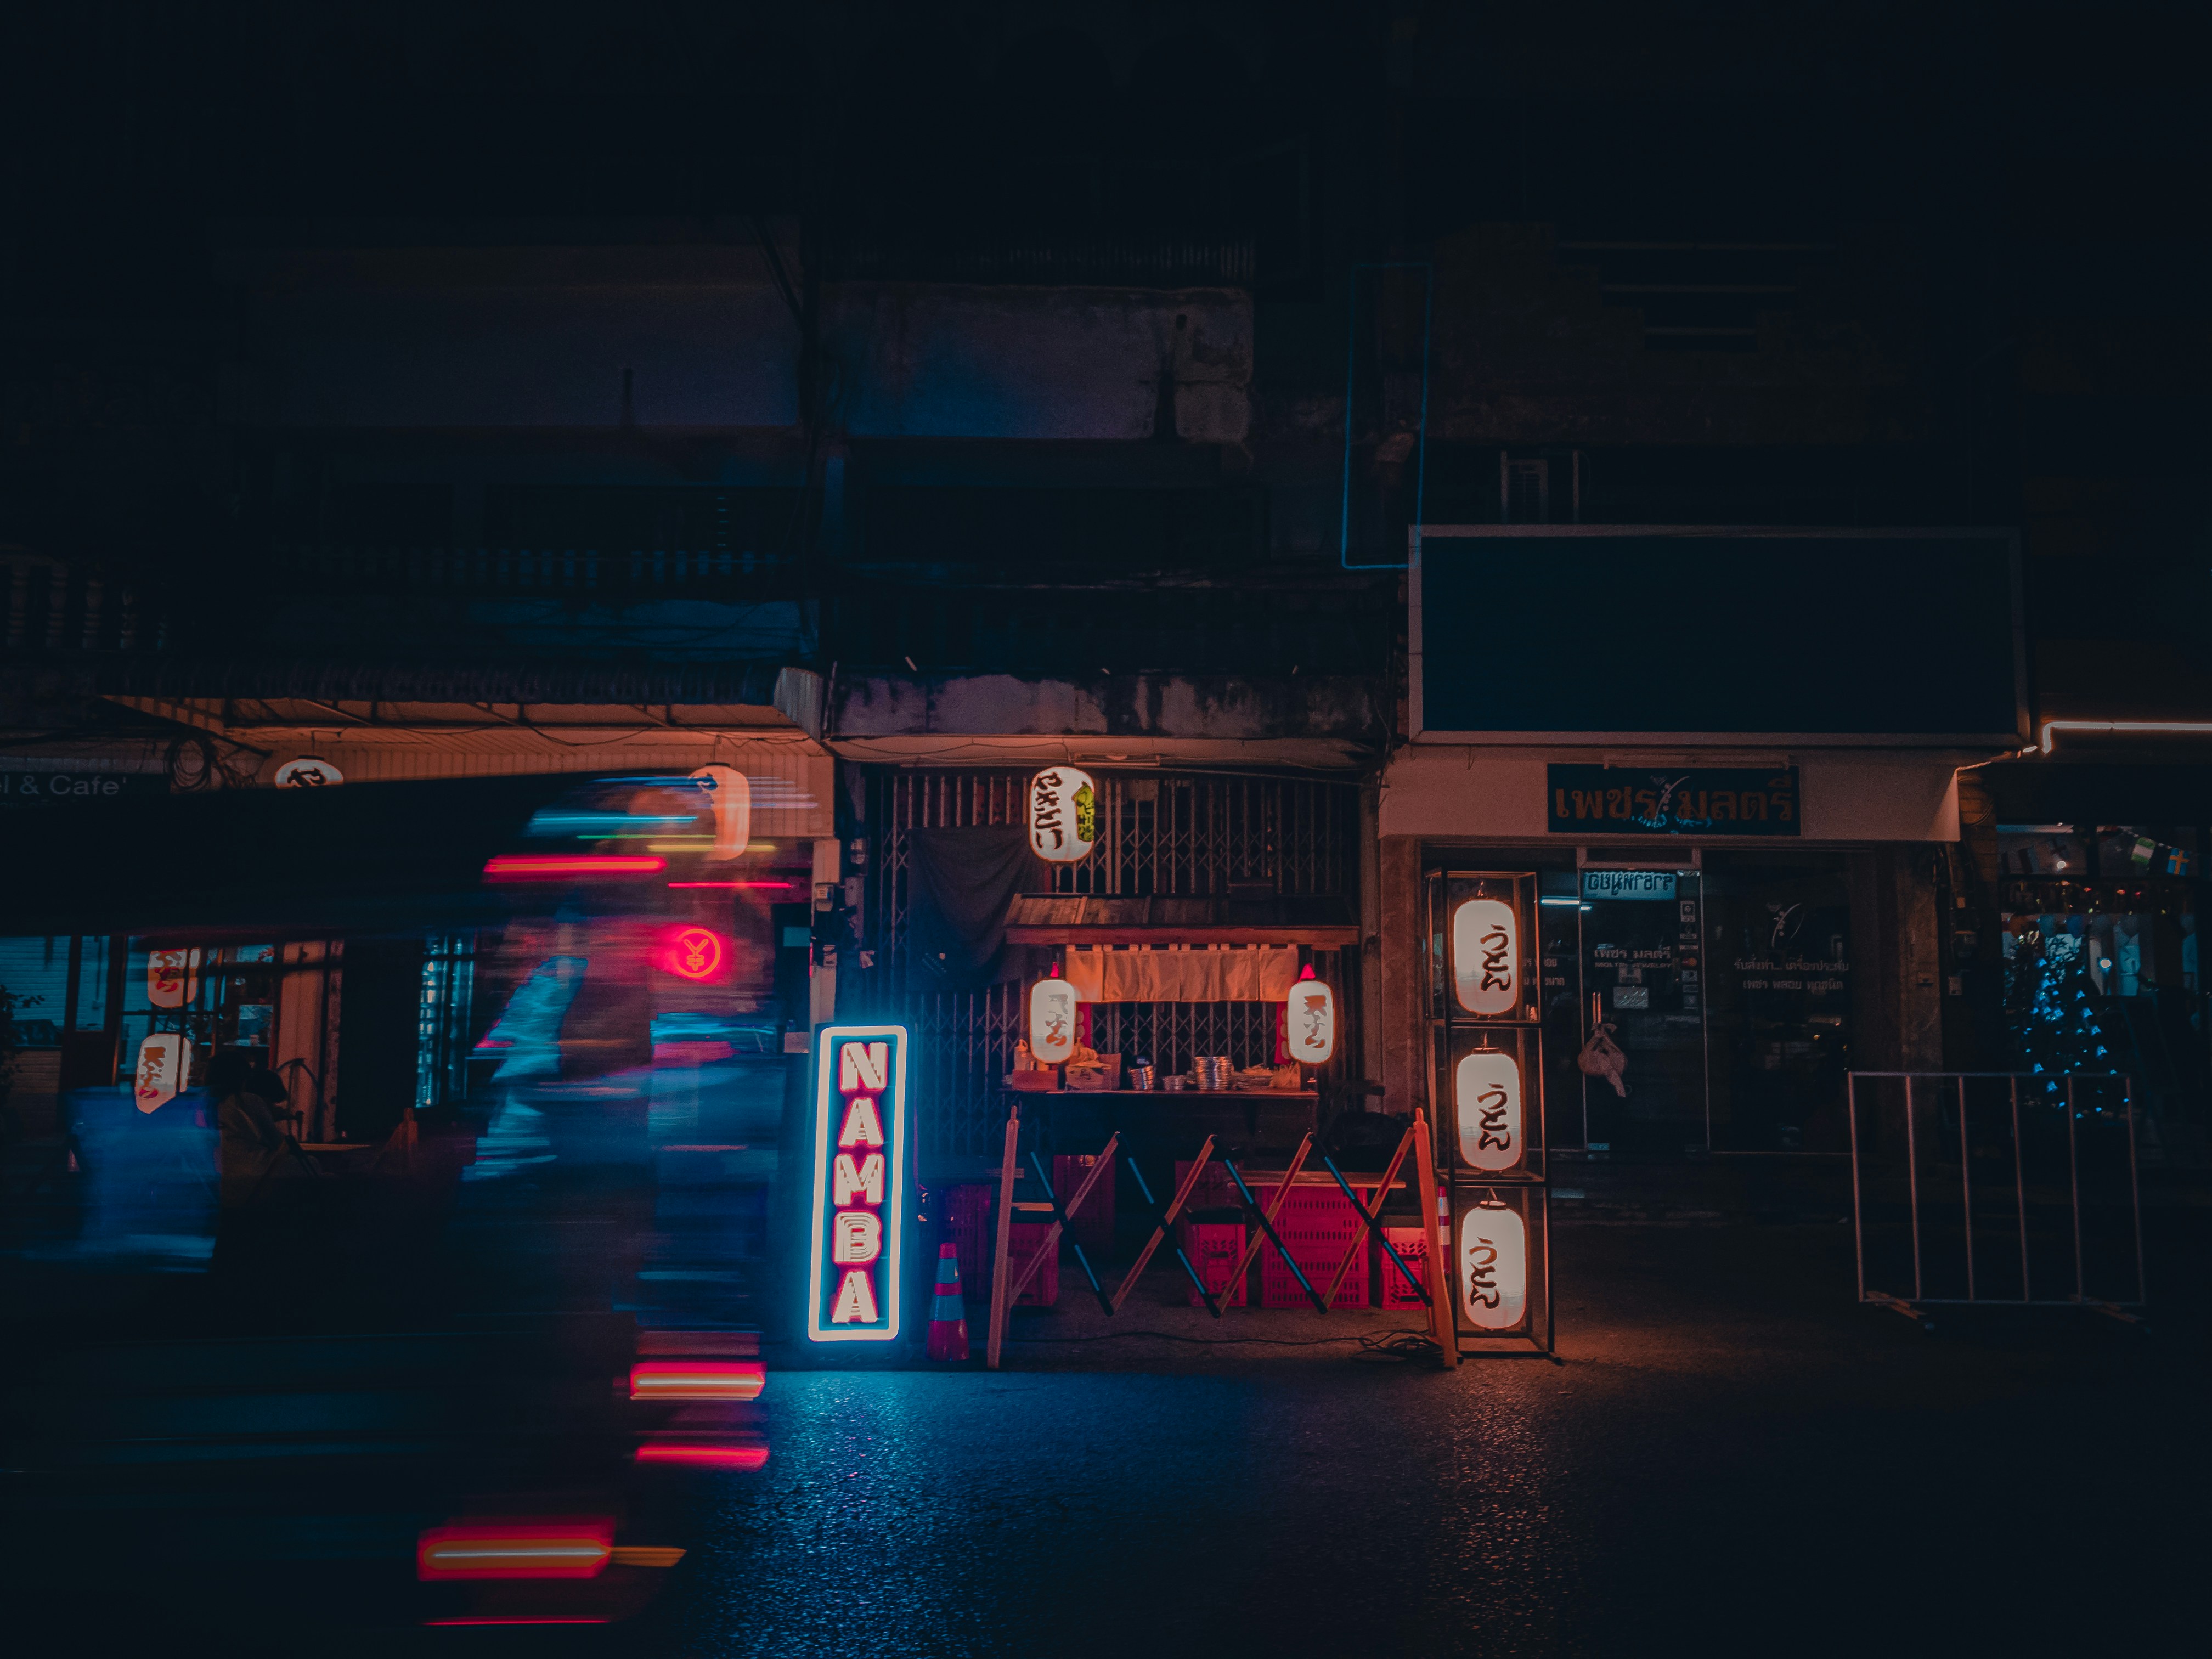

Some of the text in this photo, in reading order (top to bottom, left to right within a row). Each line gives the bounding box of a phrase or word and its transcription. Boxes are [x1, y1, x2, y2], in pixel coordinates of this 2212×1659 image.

[20, 775, 41, 795] &
[1035, 772, 1063, 849] やきとり
[1480, 924, 1511, 992] うどん
[1478, 1084, 1511, 1152] うどん
[832, 1042, 889, 1323] NAMBA
[1469, 1237, 1499, 1310] うどん
